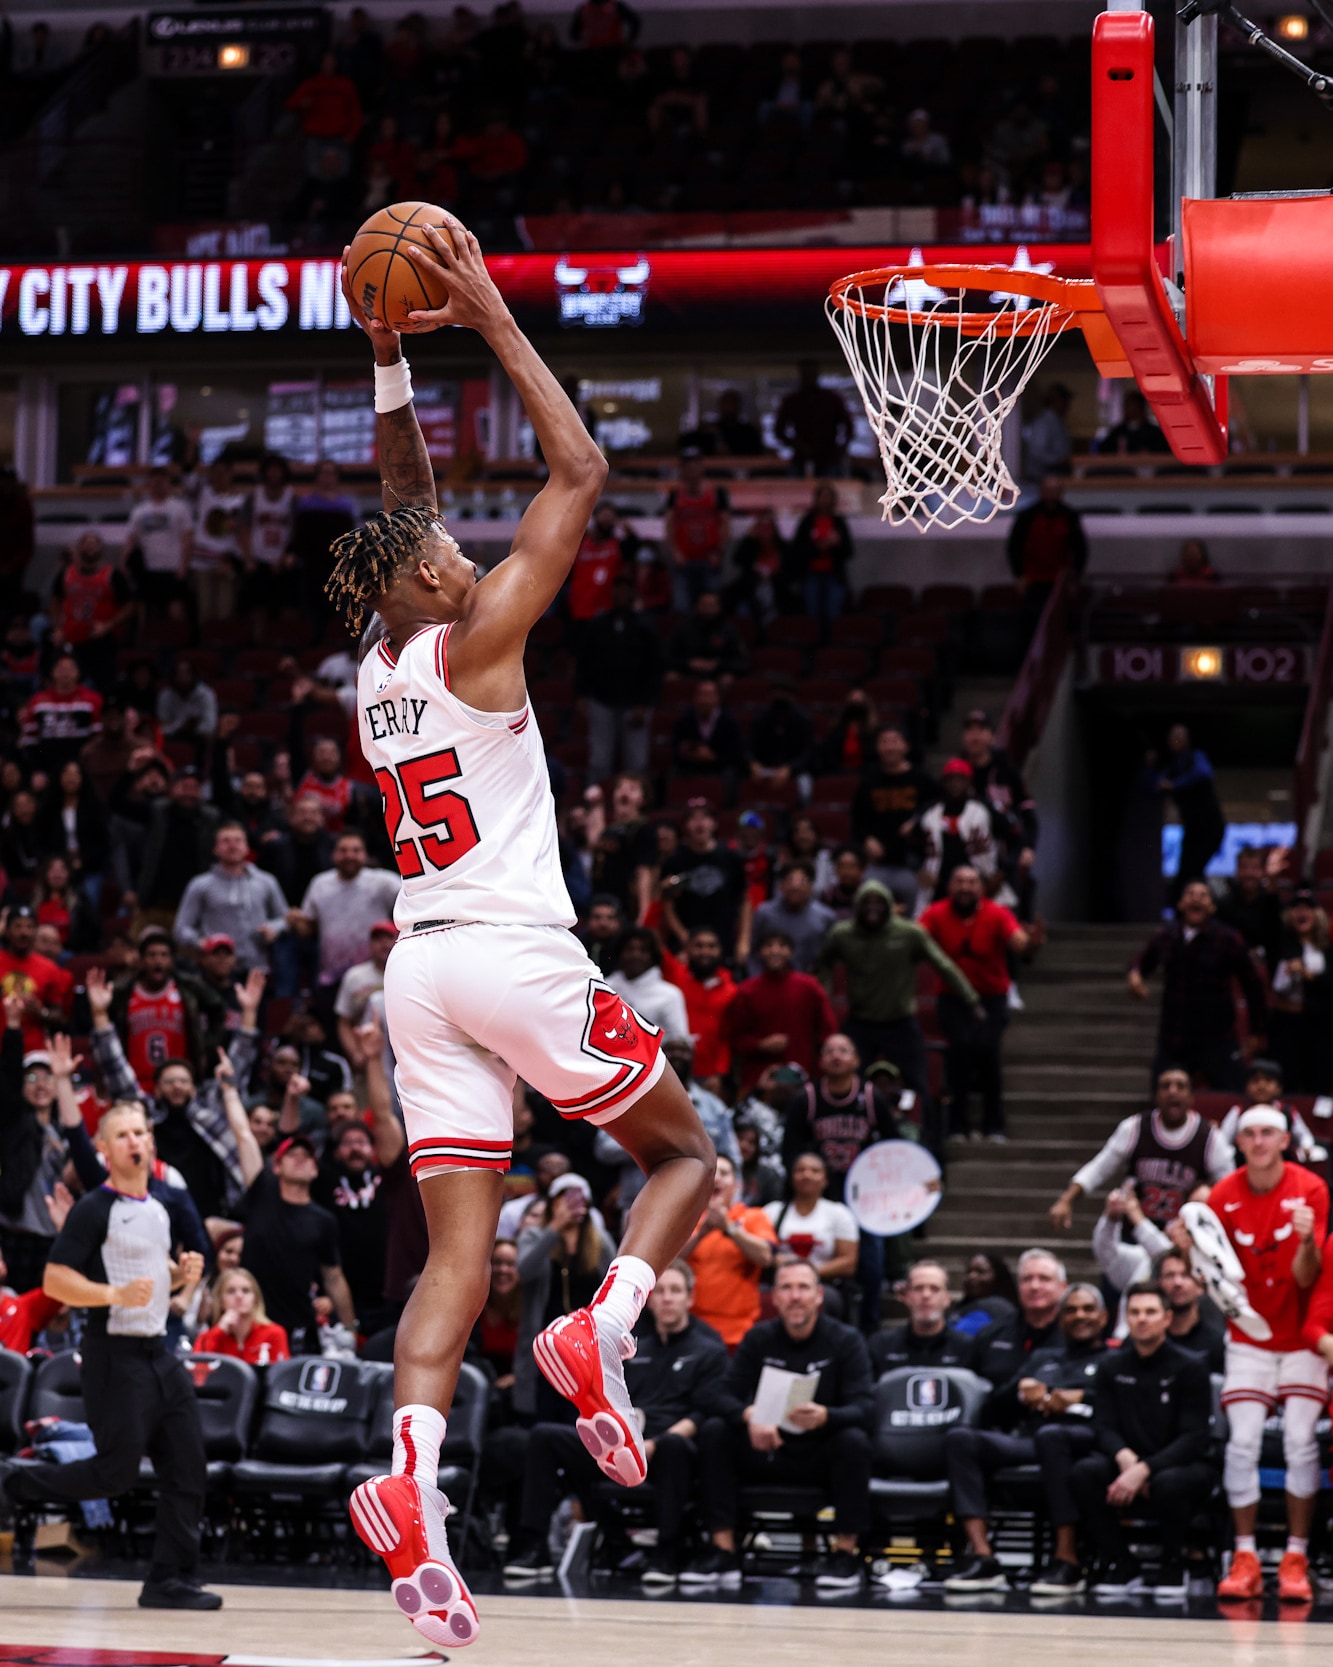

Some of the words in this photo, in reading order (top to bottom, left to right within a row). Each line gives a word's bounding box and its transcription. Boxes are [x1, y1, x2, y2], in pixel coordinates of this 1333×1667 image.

[19, 266, 129, 336] CITY
[136, 262, 290, 334] BULLS
[1114, 647, 1163, 681] 101
[1235, 647, 1295, 681] 102
[365, 697, 429, 742] ERRY
[374, 747, 481, 880] 25
[1141, 1185, 1182, 1221] 23
